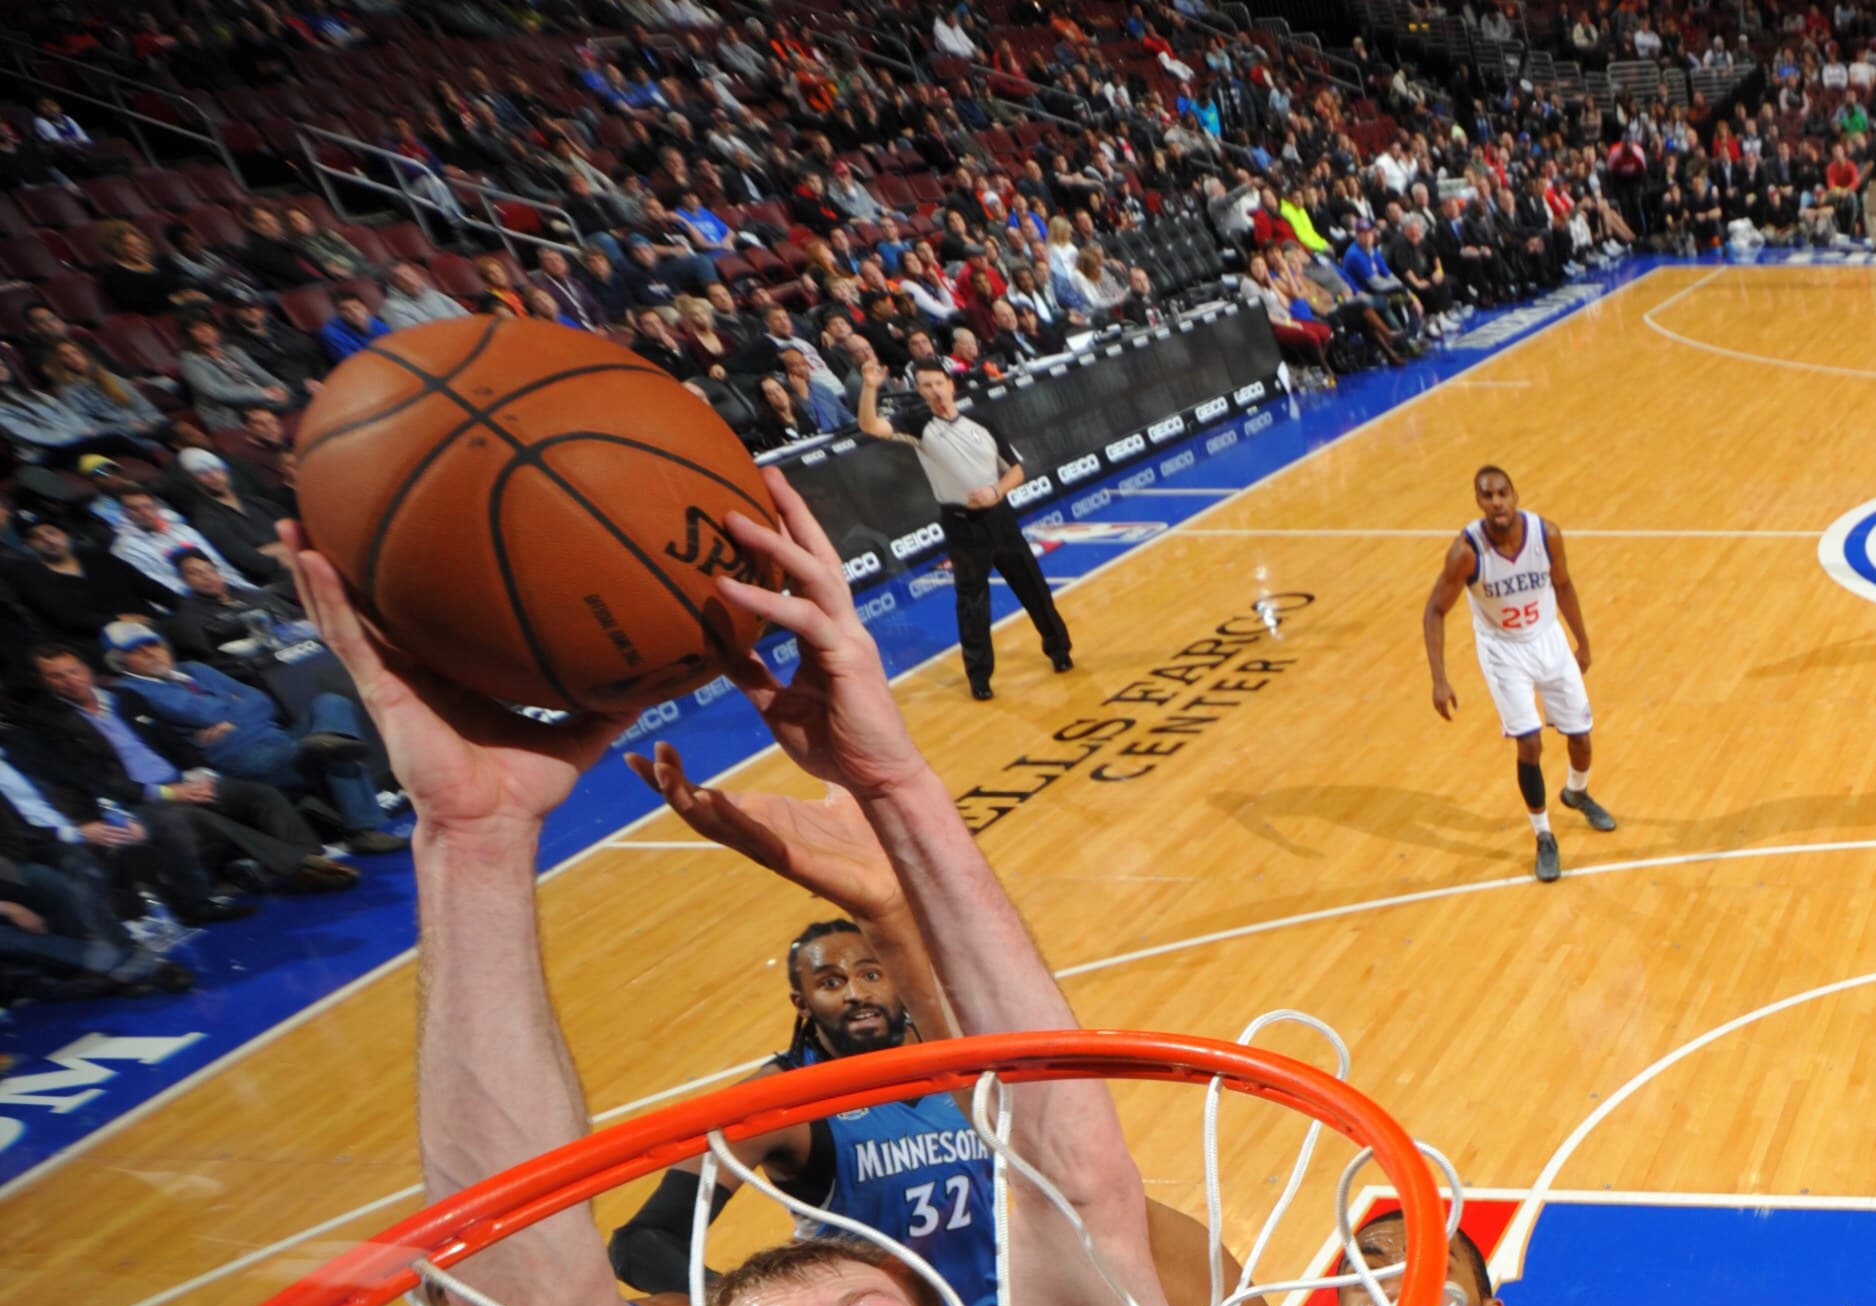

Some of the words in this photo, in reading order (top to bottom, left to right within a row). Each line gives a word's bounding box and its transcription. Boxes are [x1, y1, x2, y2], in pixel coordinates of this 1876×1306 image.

[1195, 396, 1229, 424] GEICO
[1147, 415, 1184, 444] GEICO
[1105, 433, 1146, 463] GEICO
[1057, 454, 1100, 485] GEICO
[1006, 475, 1052, 508] GEICO
[1072, 488, 1111, 518] GEICO
[890, 522, 945, 560] GEICO
[842, 551, 881, 582] EICO
[909, 570, 952, 599] GEIC
[856, 592, 896, 623] EICO
[1501, 600, 1540, 628] 25
[1089, 658, 1298, 782] CENTER
[954, 717, 1137, 836] ELLS
[905, 1175, 972, 1238] 32
